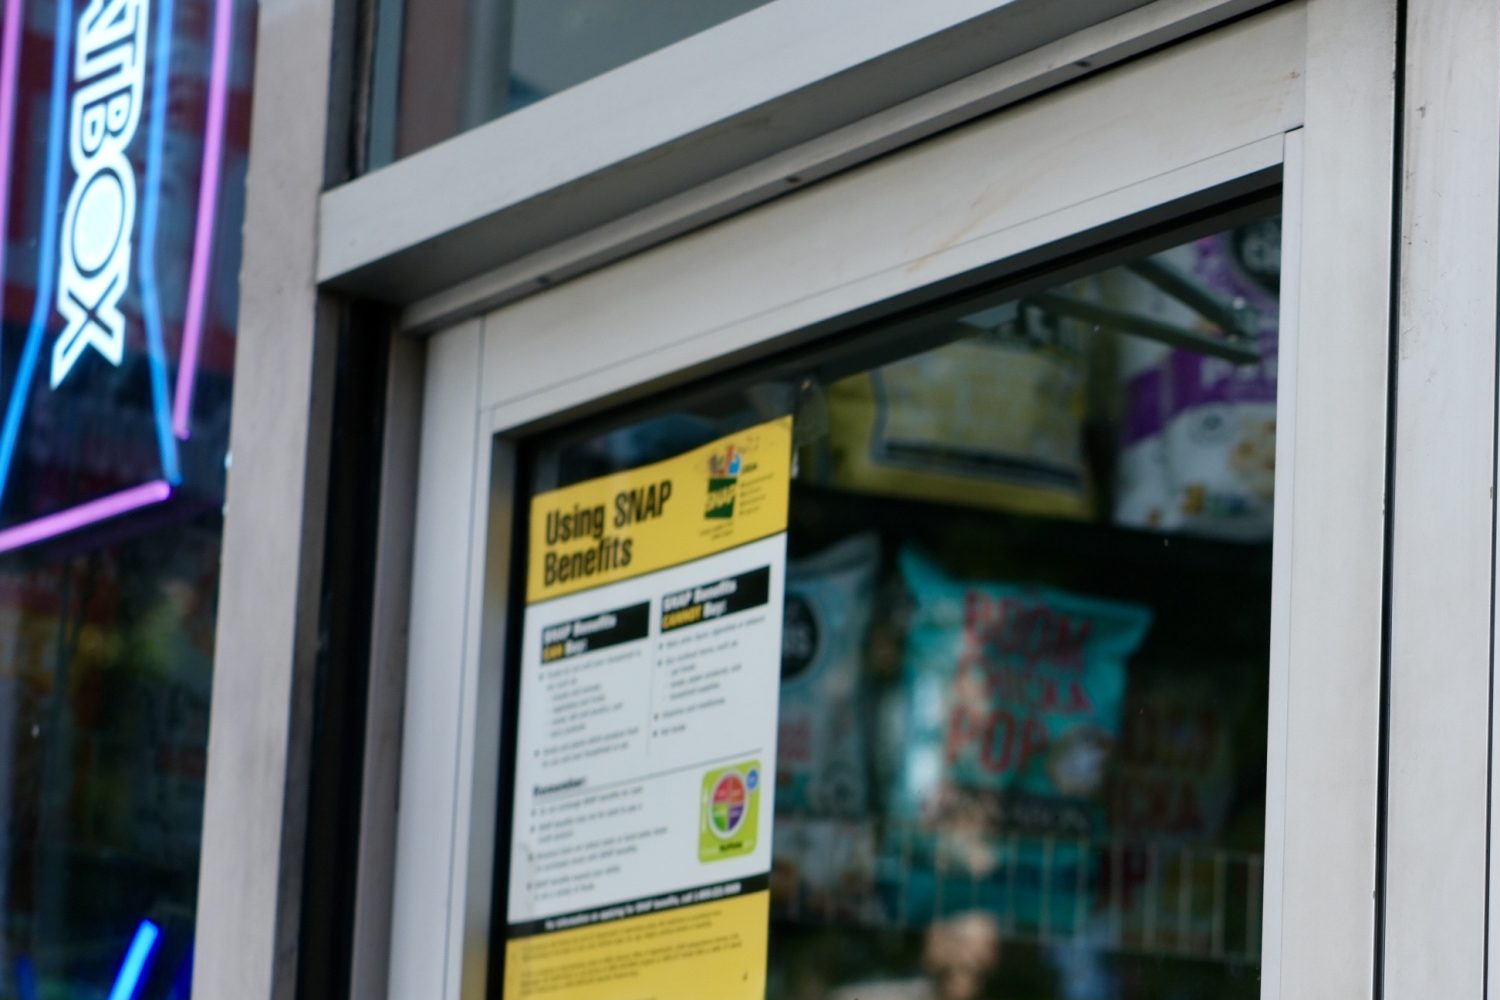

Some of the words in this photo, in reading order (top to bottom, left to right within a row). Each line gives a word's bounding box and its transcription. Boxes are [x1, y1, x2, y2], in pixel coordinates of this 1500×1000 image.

[545, 504, 605, 546] Using
[614, 480, 672, 528] SNAP
[544, 538, 633, 587] Benefits
